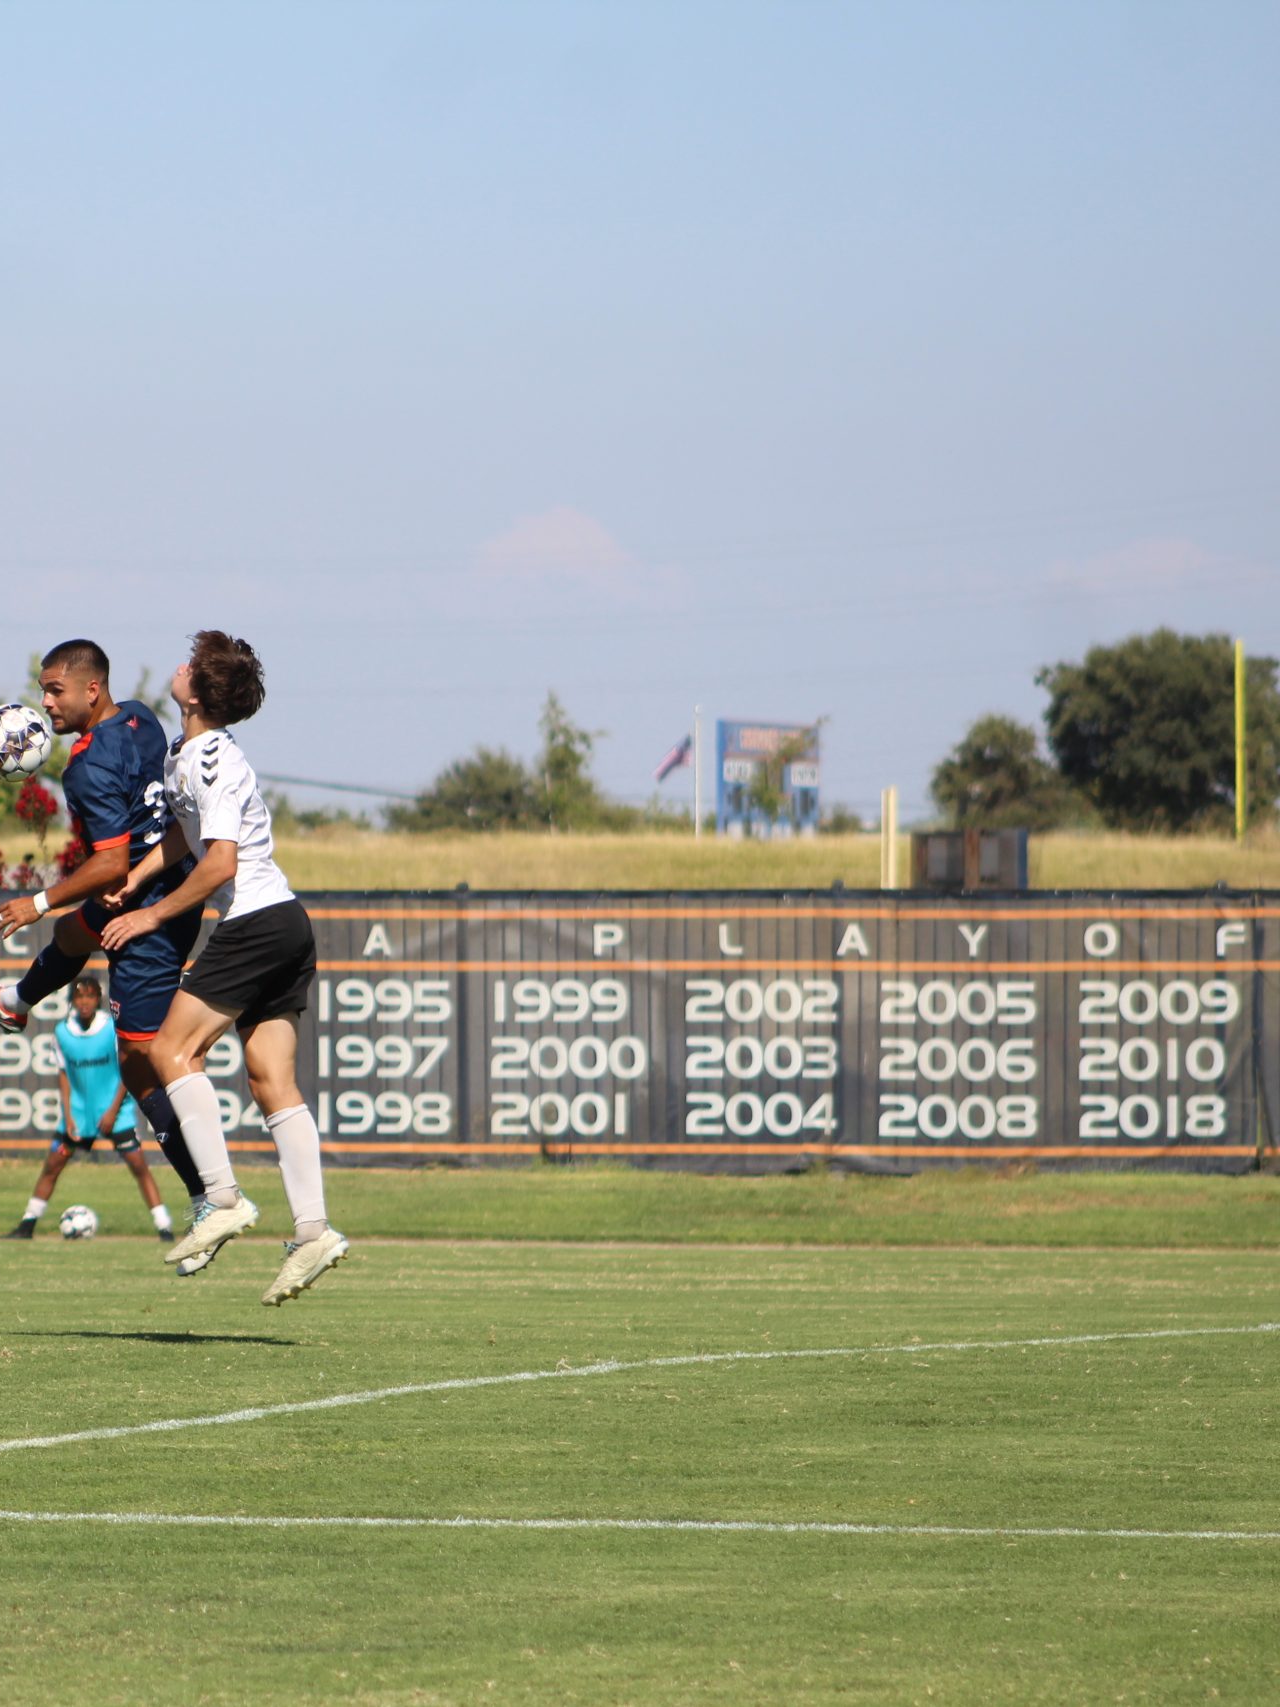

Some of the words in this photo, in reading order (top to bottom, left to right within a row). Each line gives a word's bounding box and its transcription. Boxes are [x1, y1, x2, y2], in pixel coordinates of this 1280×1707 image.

[318, 979, 452, 1023] 1995
[495, 979, 628, 1023] 1999
[686, 979, 838, 1023] 2002
[880, 980, 1037, 1025] 2005
[1079, 980, 1240, 1025] 2009
[318, 1035, 450, 1079] 1997
[491, 1035, 647, 1080] 2000
[686, 1035, 837, 1080] 2003
[879, 1036, 1037, 1082] 2006
[1079, 1036, 1226, 1082] 2010
[318, 1091, 453, 1135] 1998
[491, 1091, 627, 1136] 2001
[686, 1091, 837, 1136] 2004
[879, 1093, 1038, 1138] 2008
[1079, 1094, 1226, 1138] 2018
